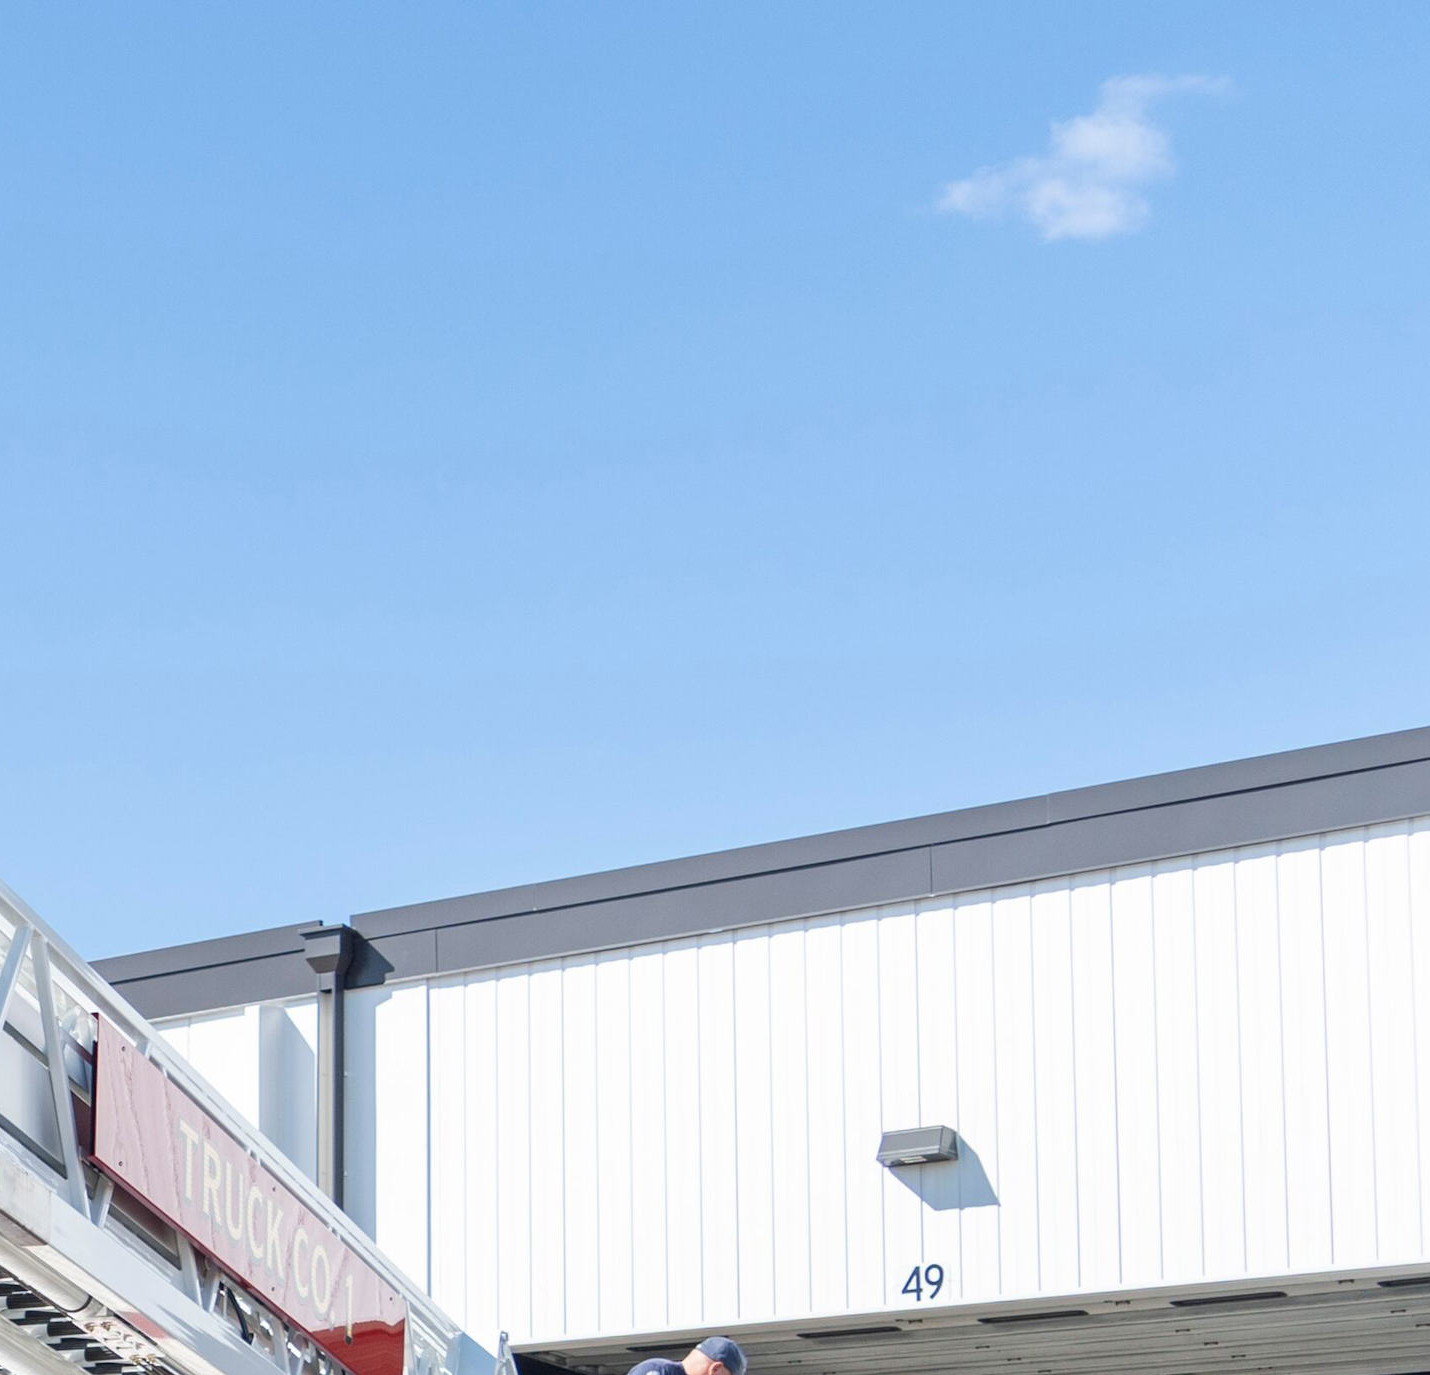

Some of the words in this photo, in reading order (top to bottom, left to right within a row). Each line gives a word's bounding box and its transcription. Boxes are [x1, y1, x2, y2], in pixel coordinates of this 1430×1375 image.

[179, 1119, 285, 1281] TRUCK
[292, 1227, 336, 1330] CO.
[345, 1275, 354, 1344] 1
[902, 1264, 944, 1301] 49
